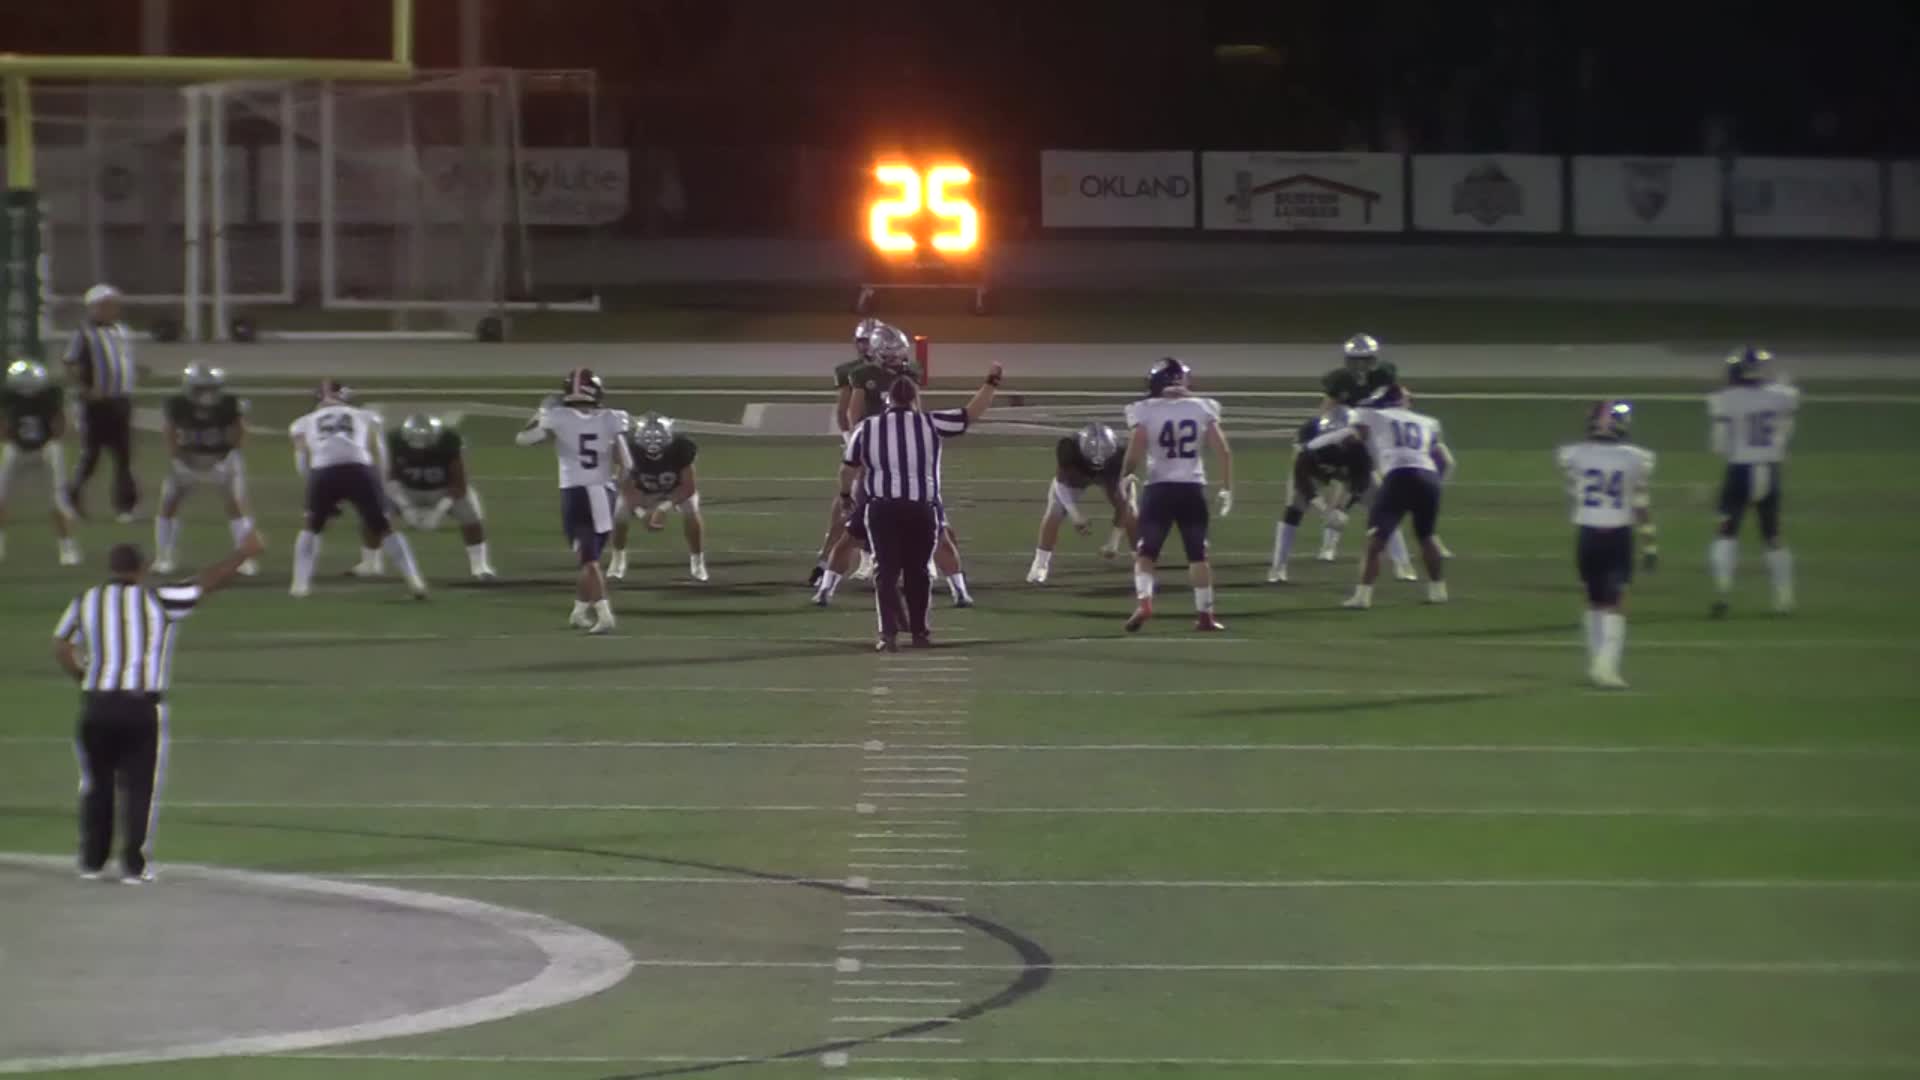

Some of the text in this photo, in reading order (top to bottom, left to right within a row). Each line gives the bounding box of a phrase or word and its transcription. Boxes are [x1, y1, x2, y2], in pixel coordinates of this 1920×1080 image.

[1079, 175, 1191, 199] OKLAND
[868, 163, 980, 254] 25
[578, 433, 599, 470] 5
[1158, 419, 1198, 459] 42
[1583, 468, 1624, 509] 24
